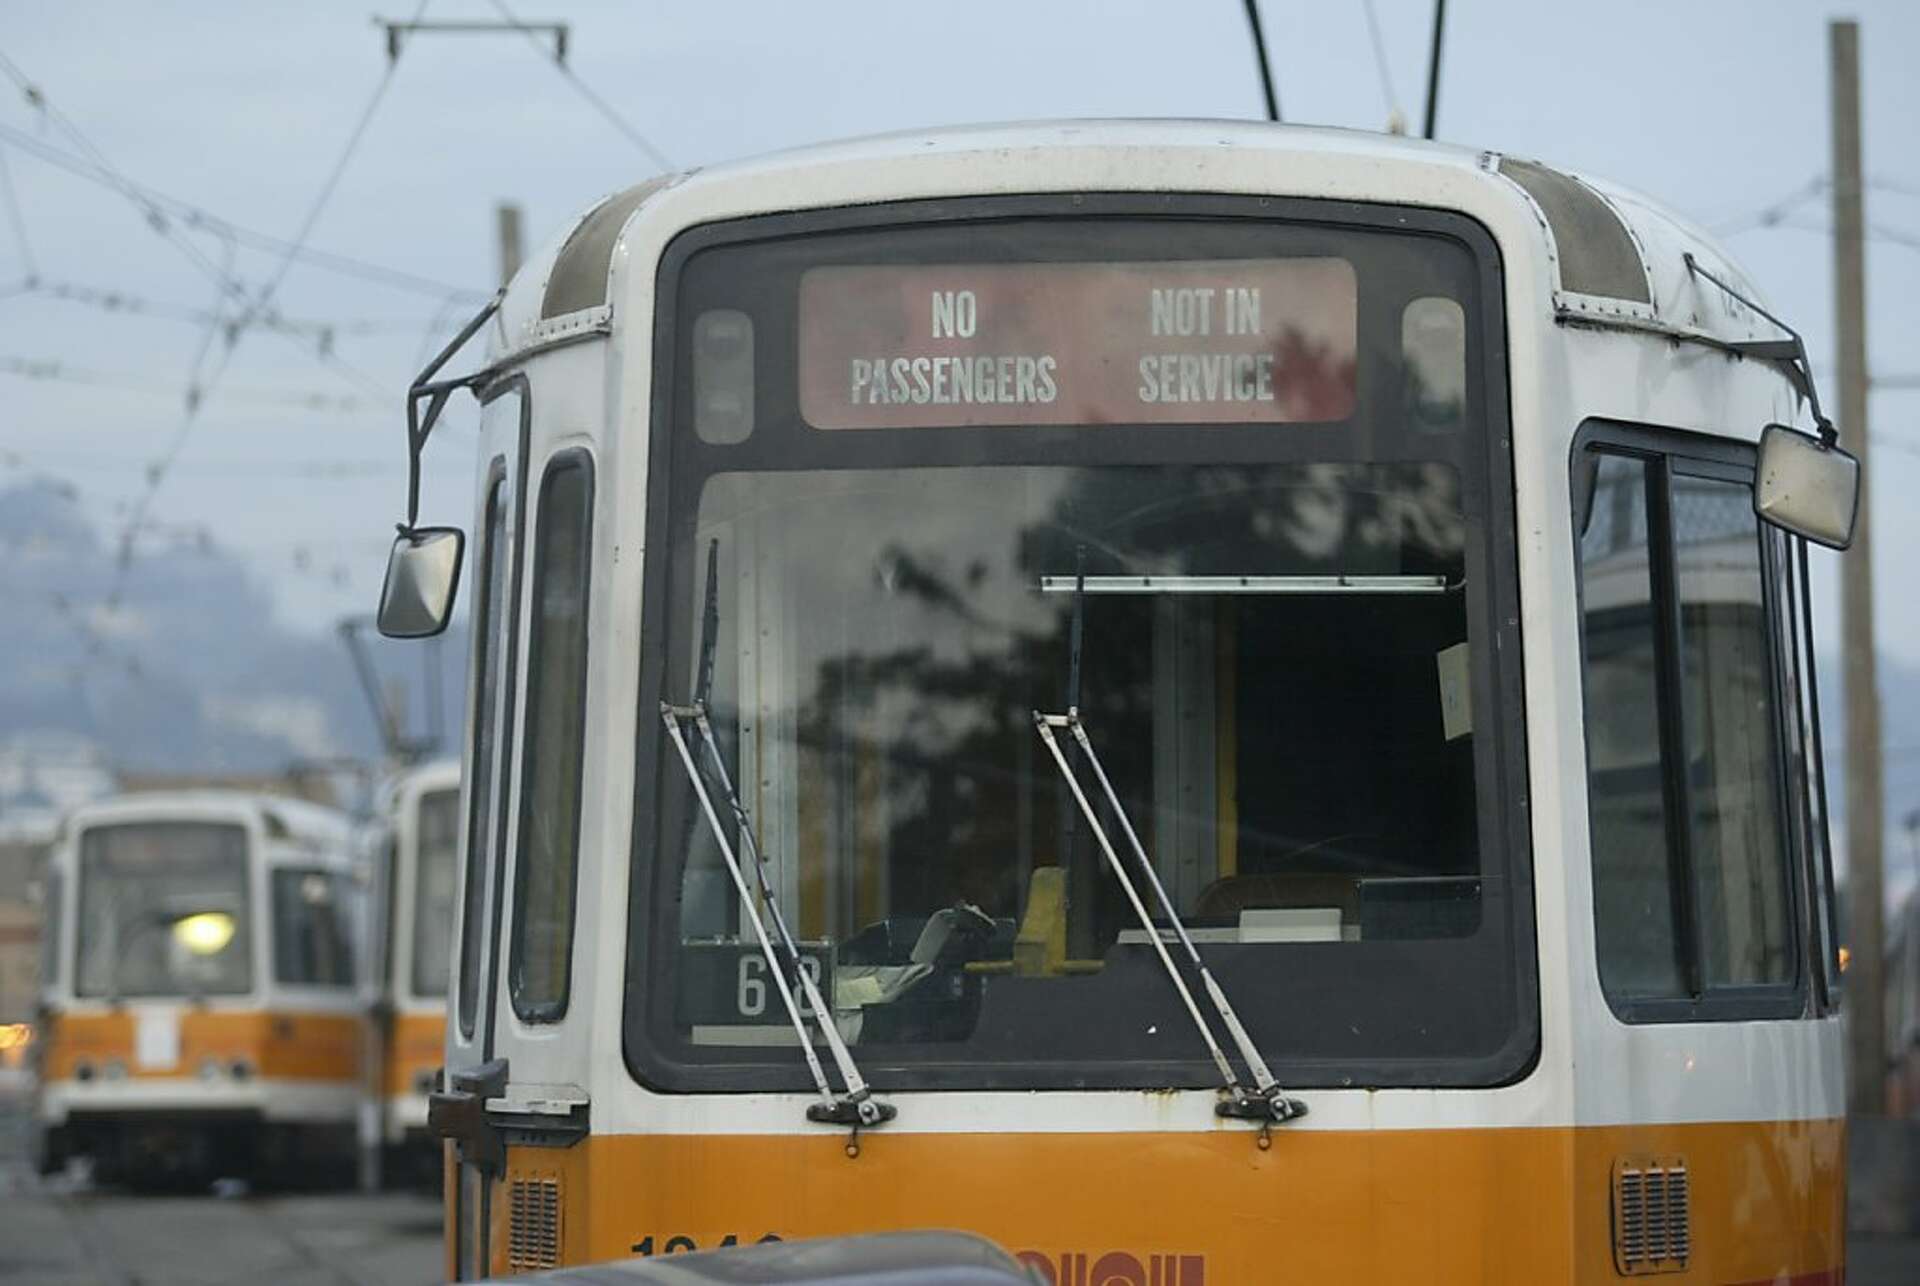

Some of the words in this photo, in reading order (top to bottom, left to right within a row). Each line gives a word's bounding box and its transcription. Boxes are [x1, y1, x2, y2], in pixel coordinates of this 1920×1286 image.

[931, 291, 976, 338] NO
[1151, 289, 1214, 336] NOT
[1225, 287, 1261, 335] IN
[851, 356, 1058, 404] PASSENGERS
[1139, 354, 1275, 402] SERVICE
